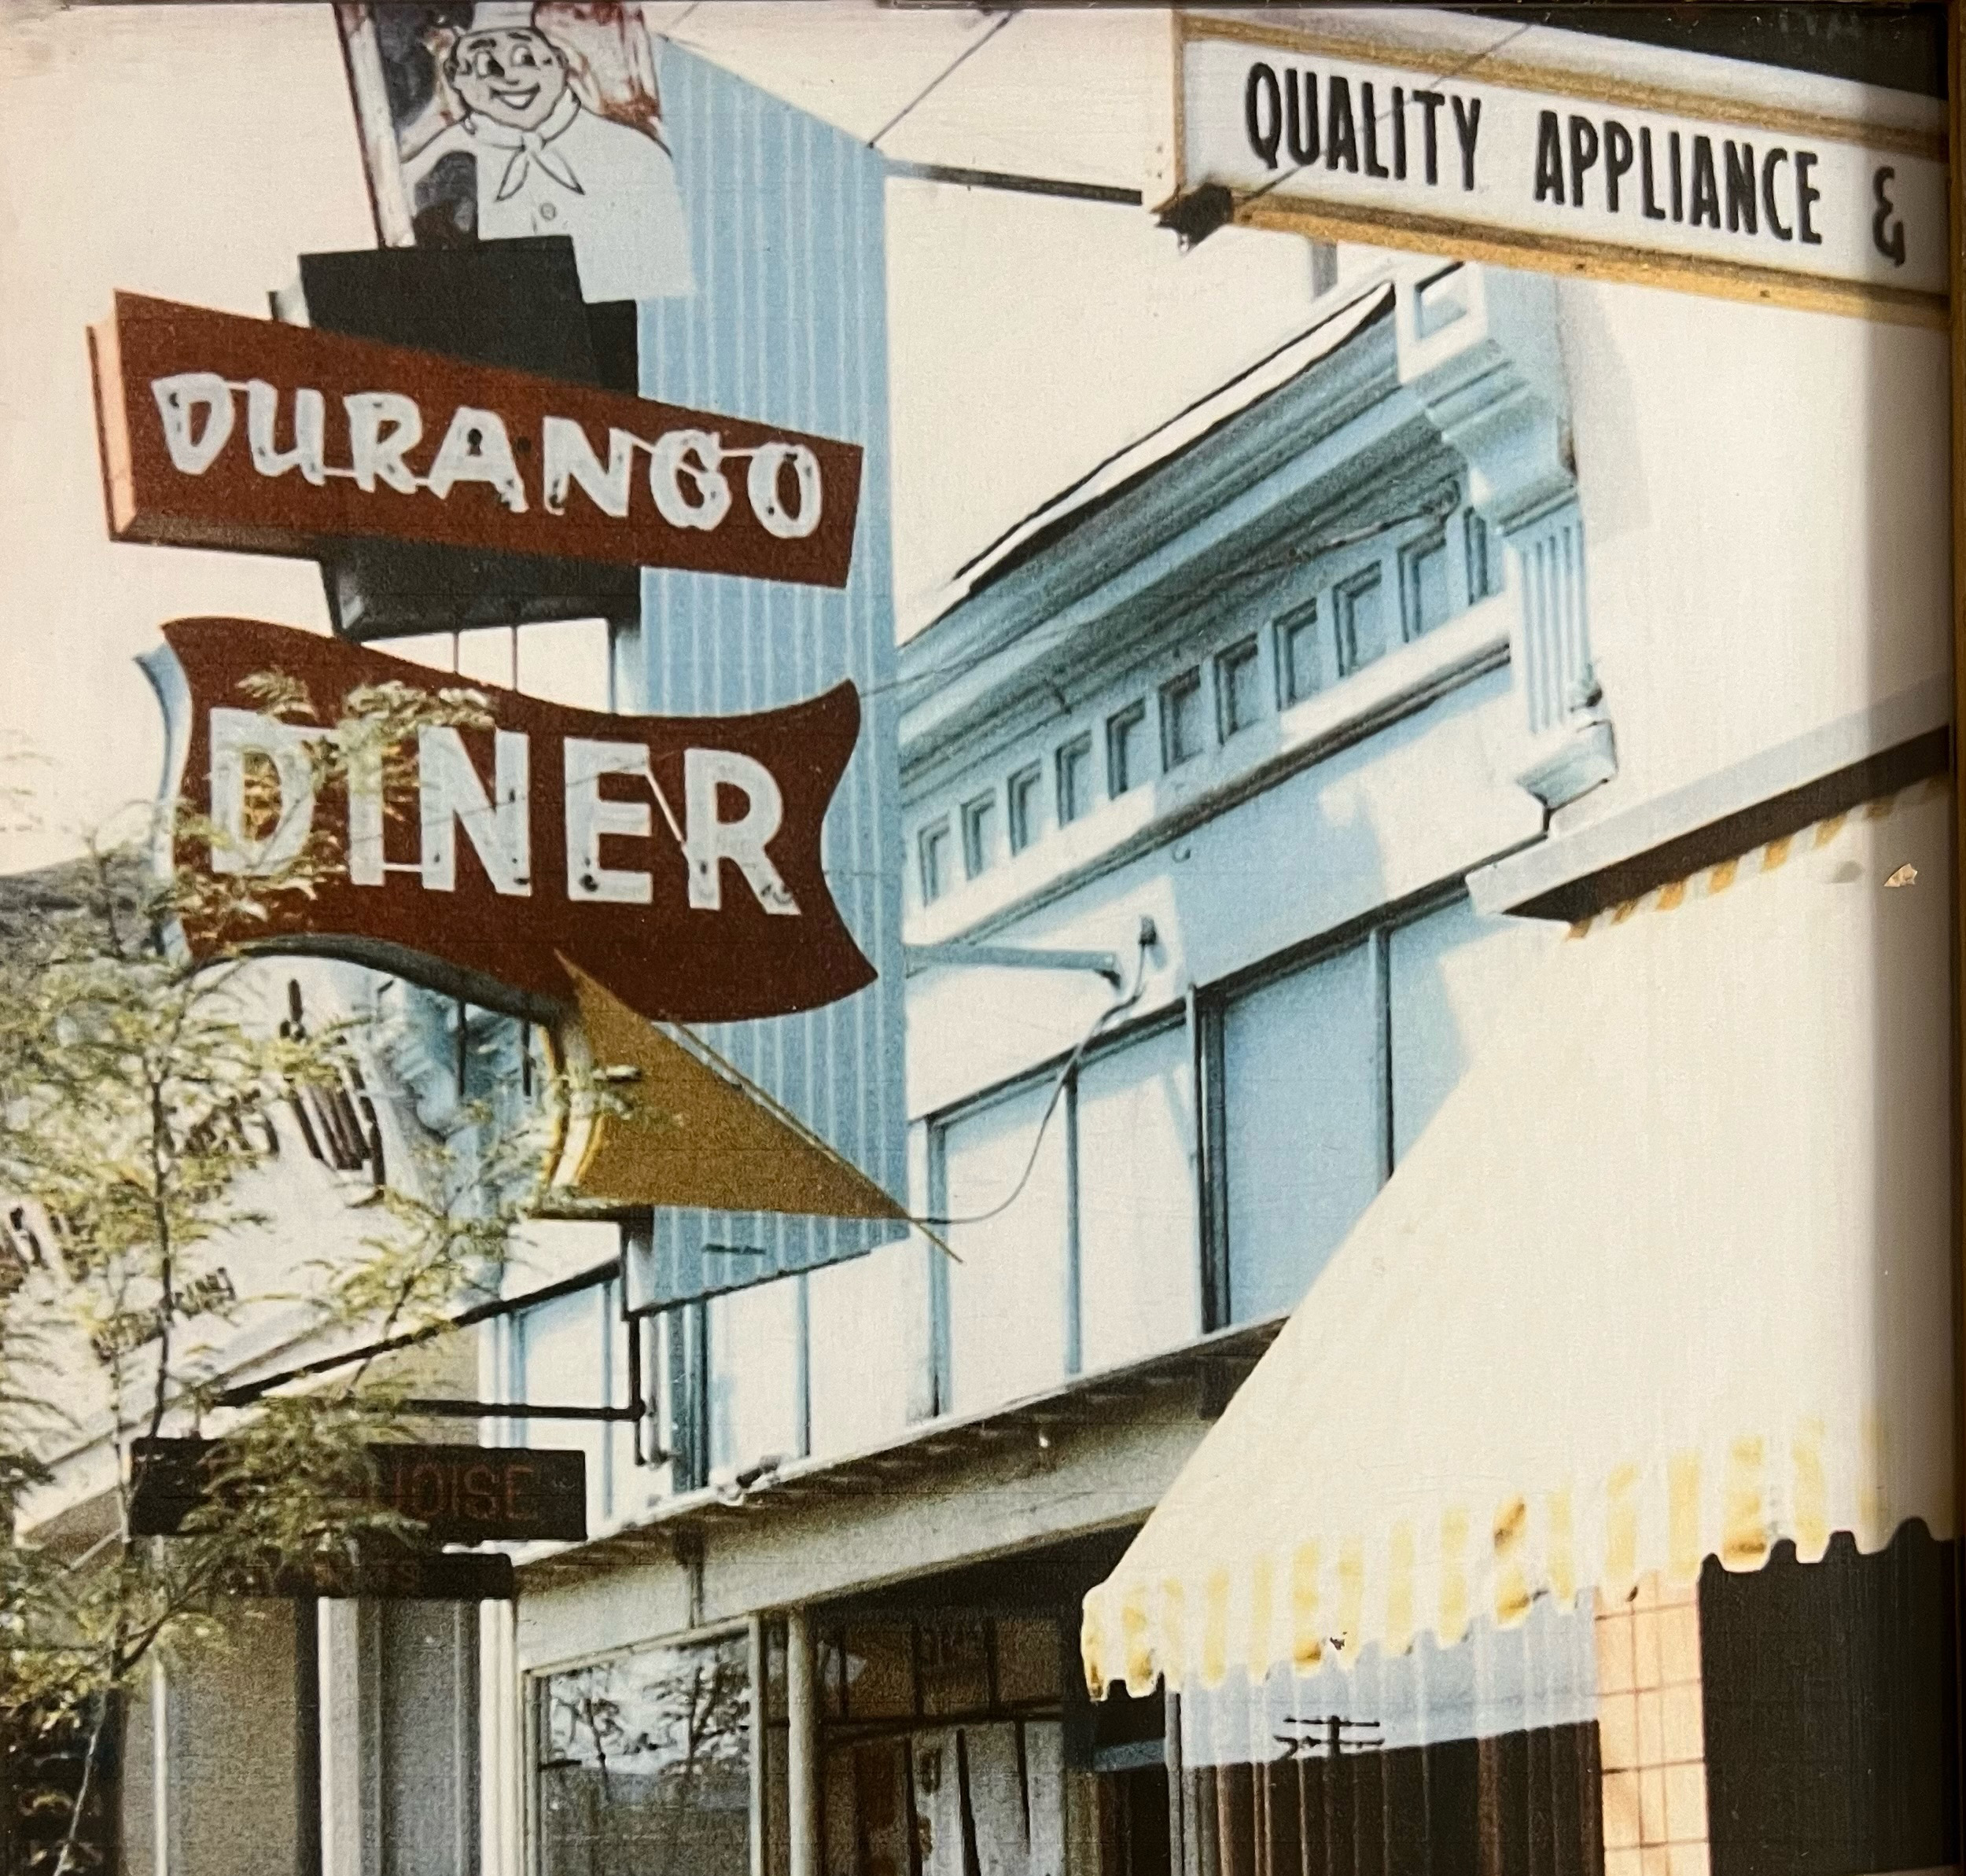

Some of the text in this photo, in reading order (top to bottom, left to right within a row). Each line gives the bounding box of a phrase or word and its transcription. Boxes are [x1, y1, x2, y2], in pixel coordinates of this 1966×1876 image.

[1246, 62, 1906, 268] QUALITY APPLIANCE &
[152, 371, 822, 539] DURANGO
[208, 708, 801, 915] DINER
